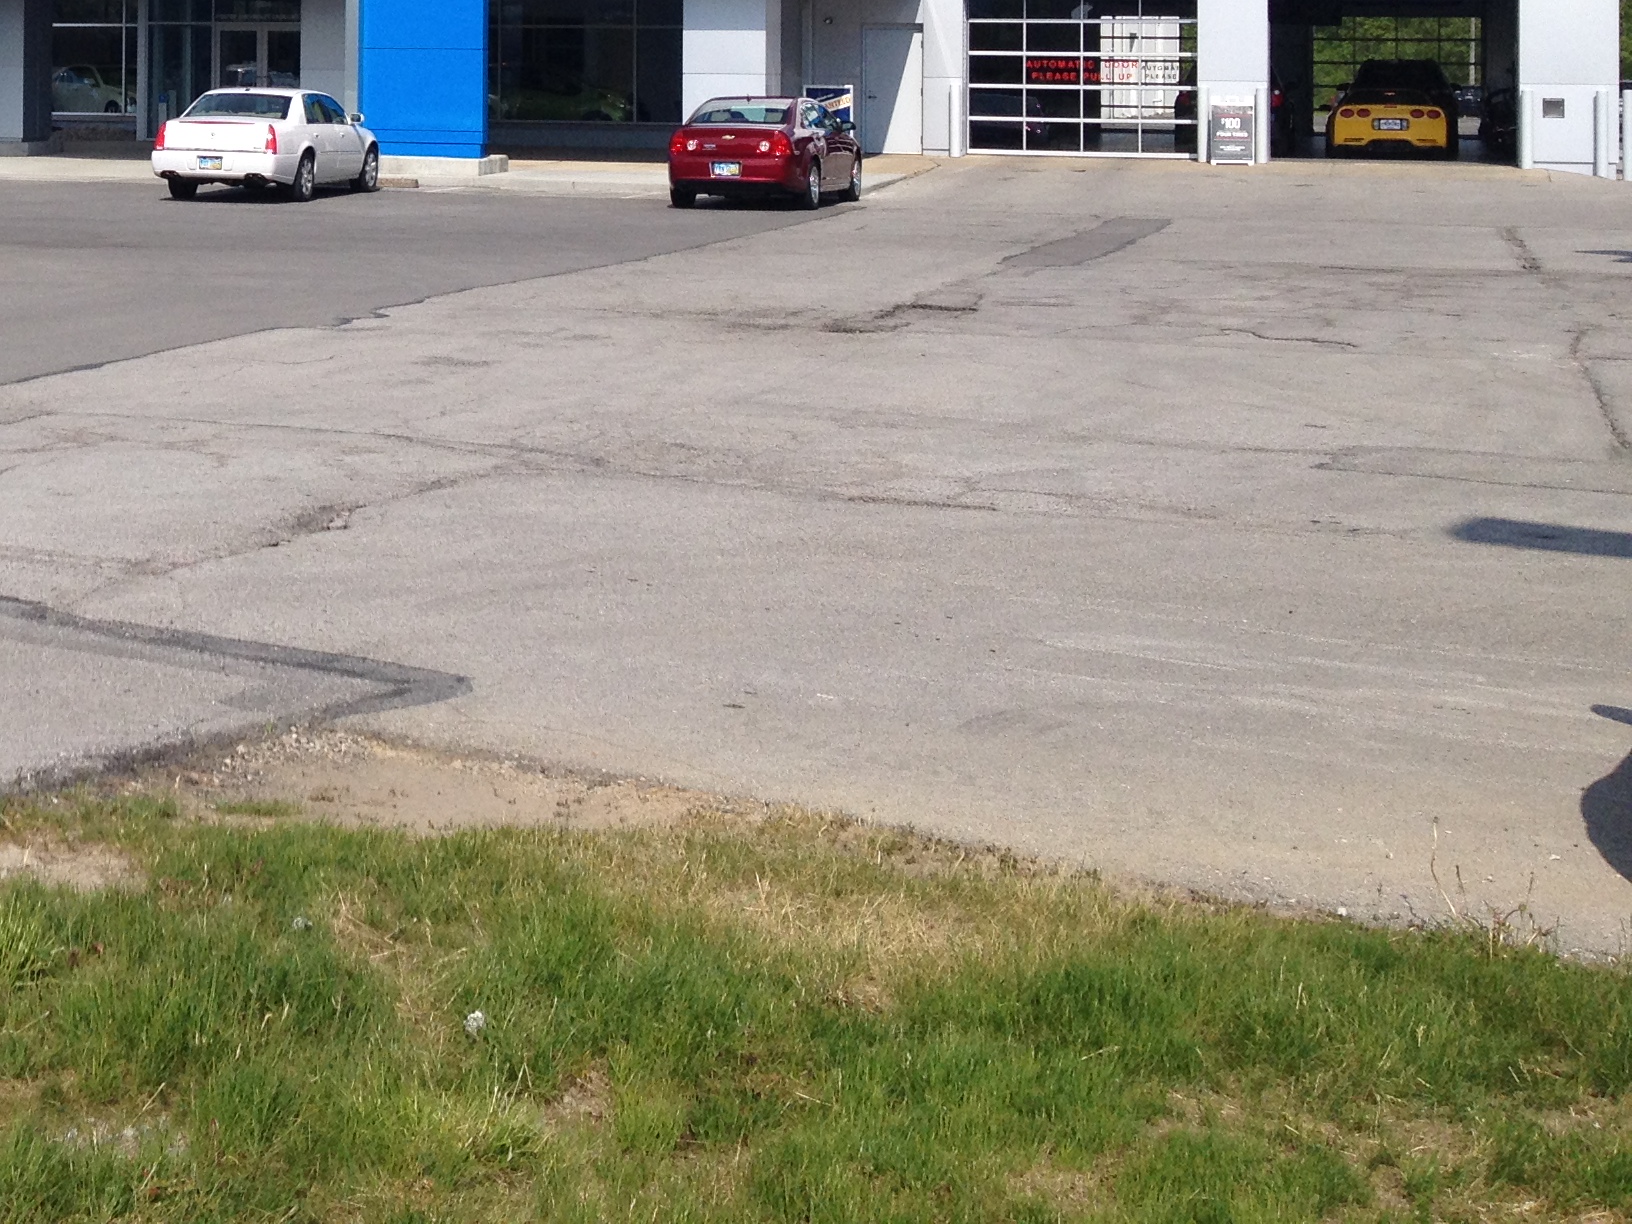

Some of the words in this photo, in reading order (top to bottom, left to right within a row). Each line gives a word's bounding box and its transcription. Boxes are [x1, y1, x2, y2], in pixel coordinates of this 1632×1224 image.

[1025, 60, 1095, 70] AUTOMATIC
[1031, 72, 1078, 81] PLEASE
[1118, 72, 1133, 81] UP
[1220, 117, 1241, 129] $100
